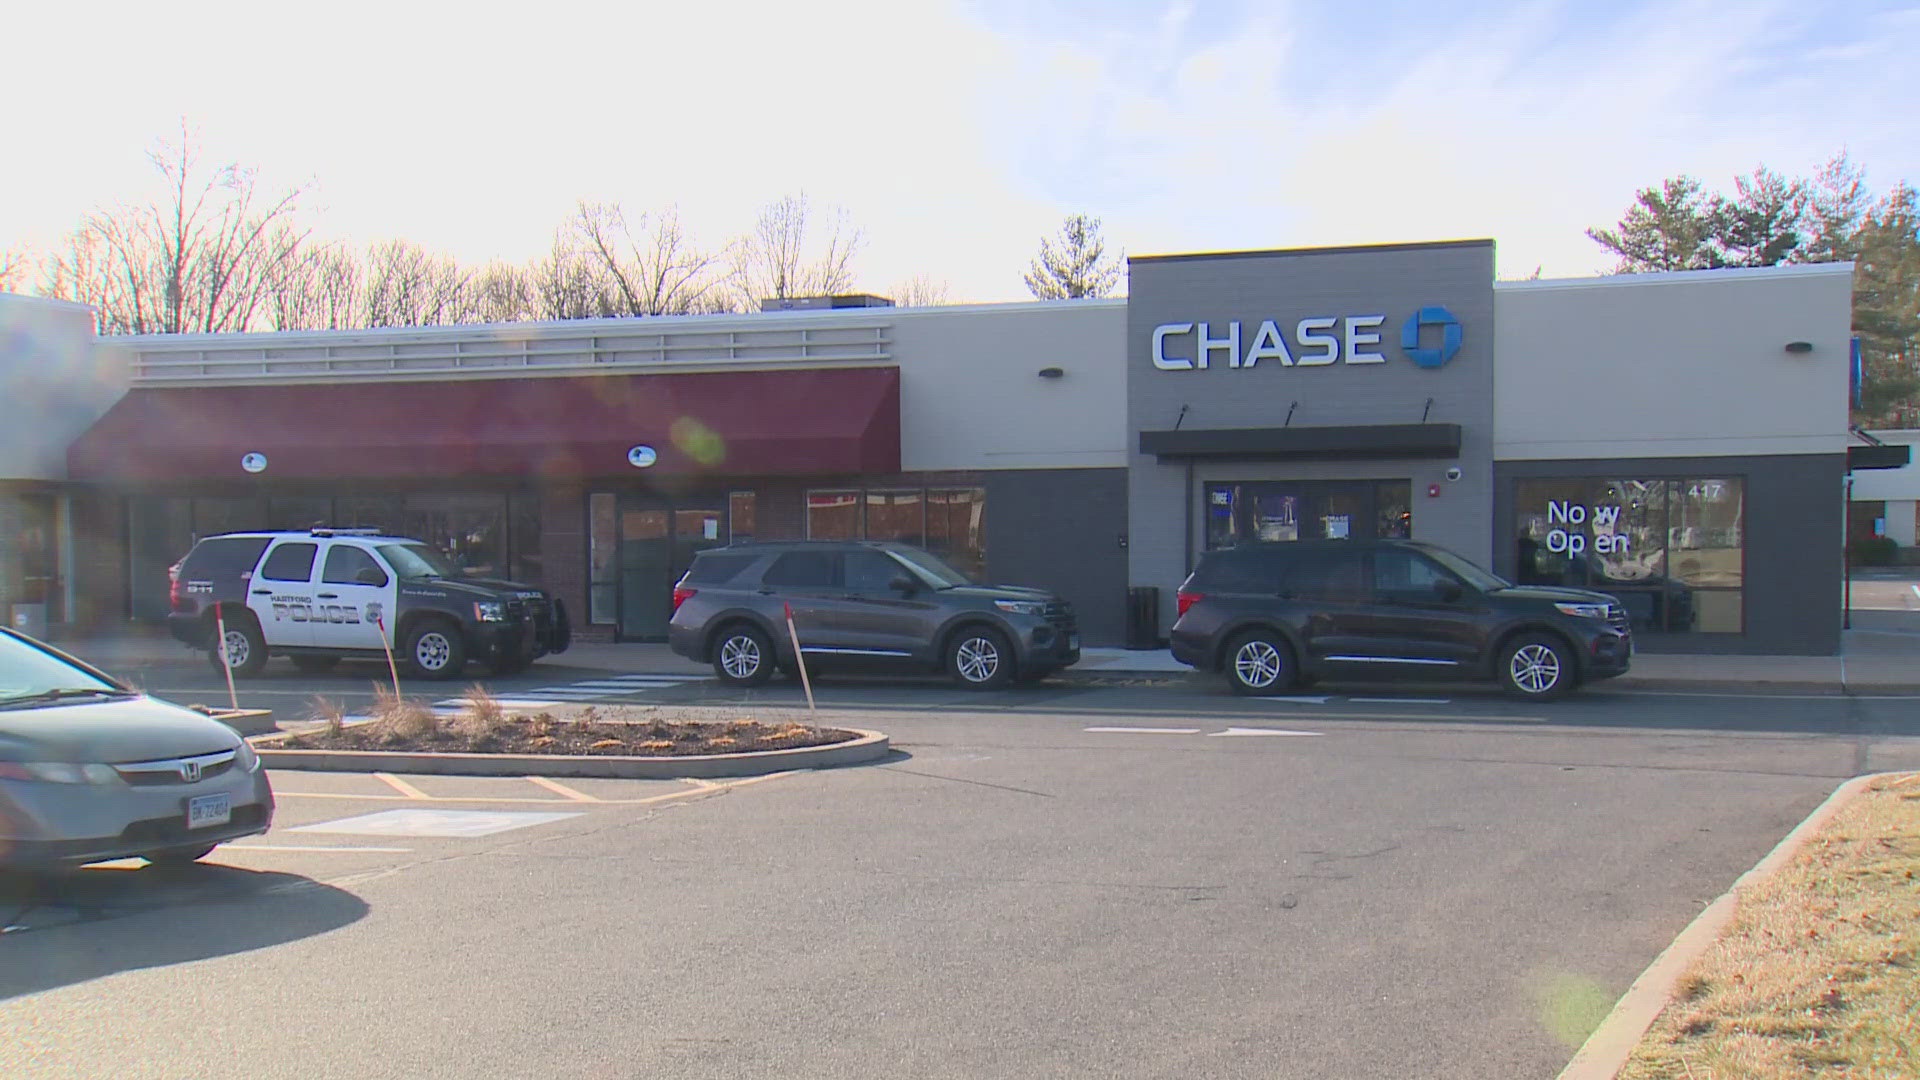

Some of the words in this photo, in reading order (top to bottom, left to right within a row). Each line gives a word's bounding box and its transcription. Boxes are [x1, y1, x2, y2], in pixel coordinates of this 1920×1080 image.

[1152, 315, 1385, 370] CHASE
[1688, 485, 1721, 498] 417
[270, 595, 312, 603] HARTFORD
[272, 603, 360, 624] POLICE
